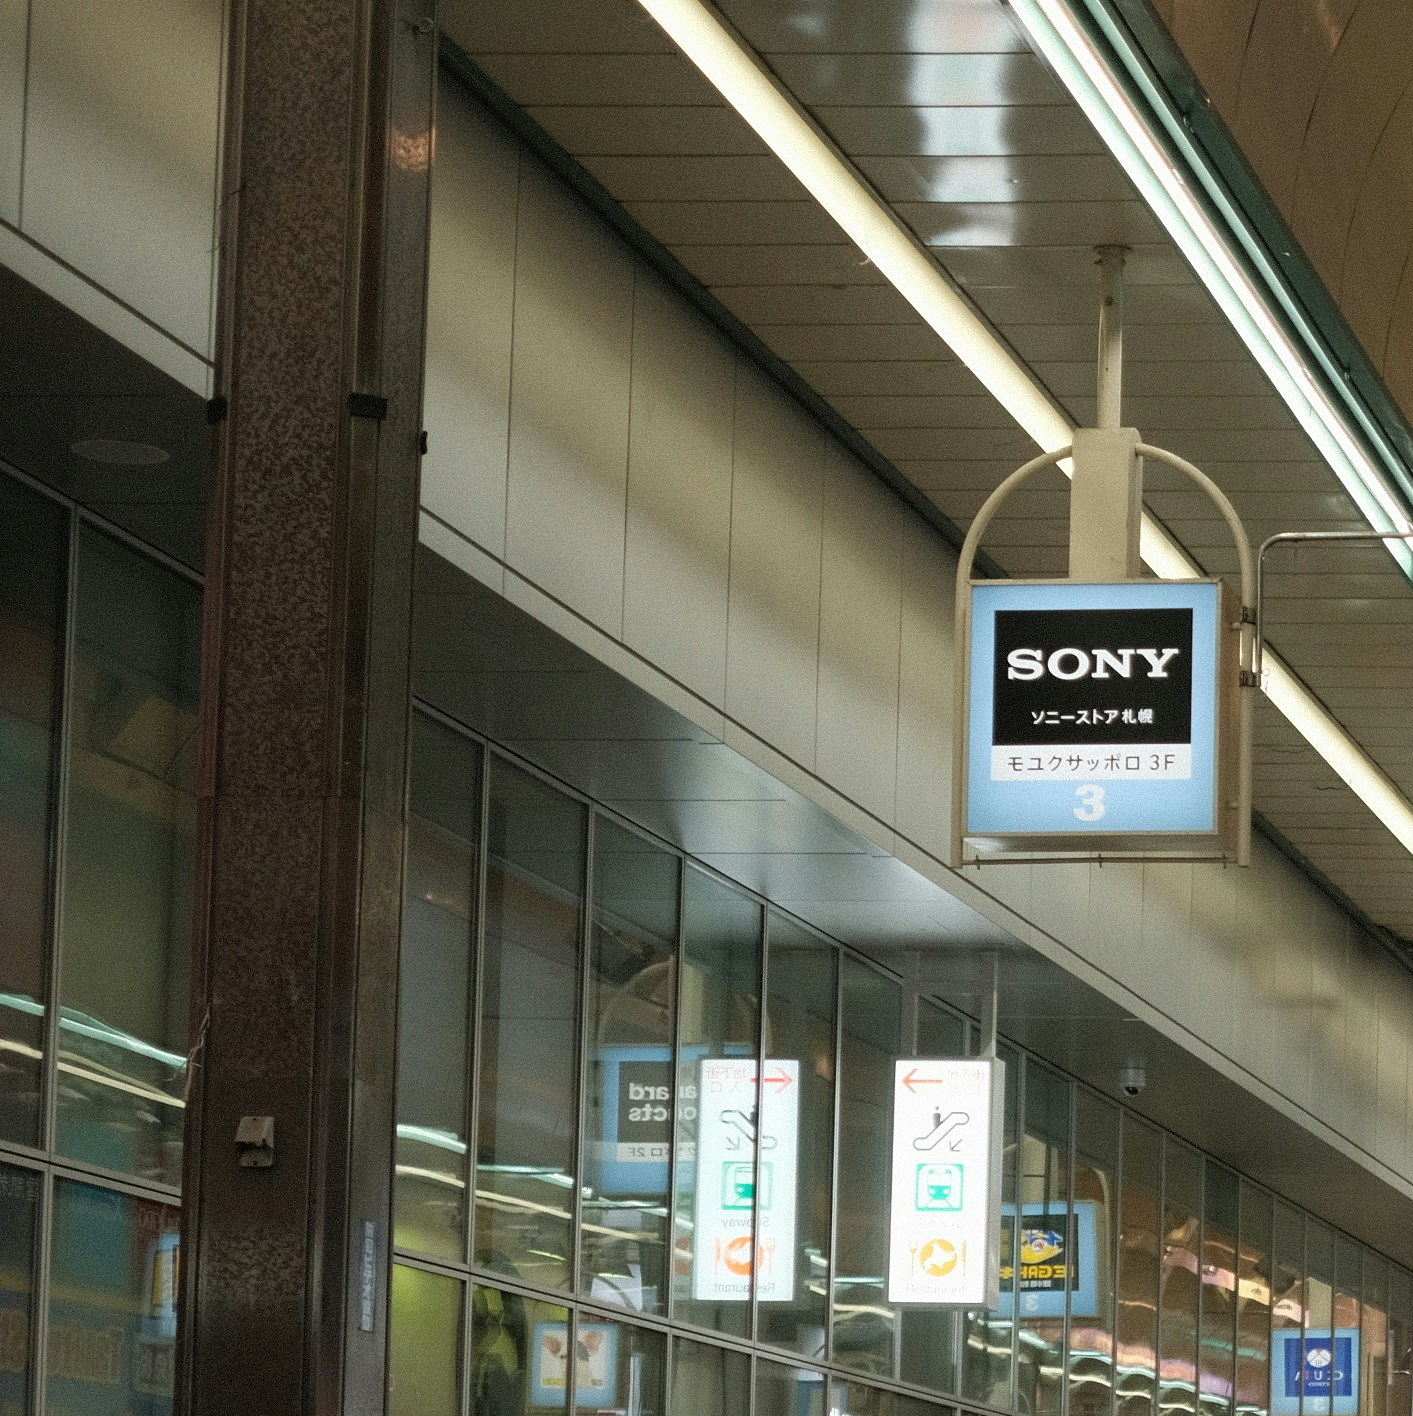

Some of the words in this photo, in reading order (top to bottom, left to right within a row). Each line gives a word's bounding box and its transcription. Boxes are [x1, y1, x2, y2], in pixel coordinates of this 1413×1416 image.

[1006, 648, 1179, 681] SONY
[1008, 754, 1140, 771] モユクサッポロ
[1150, 754, 1175, 770] 3F
[1073, 784, 1105, 821] 3
